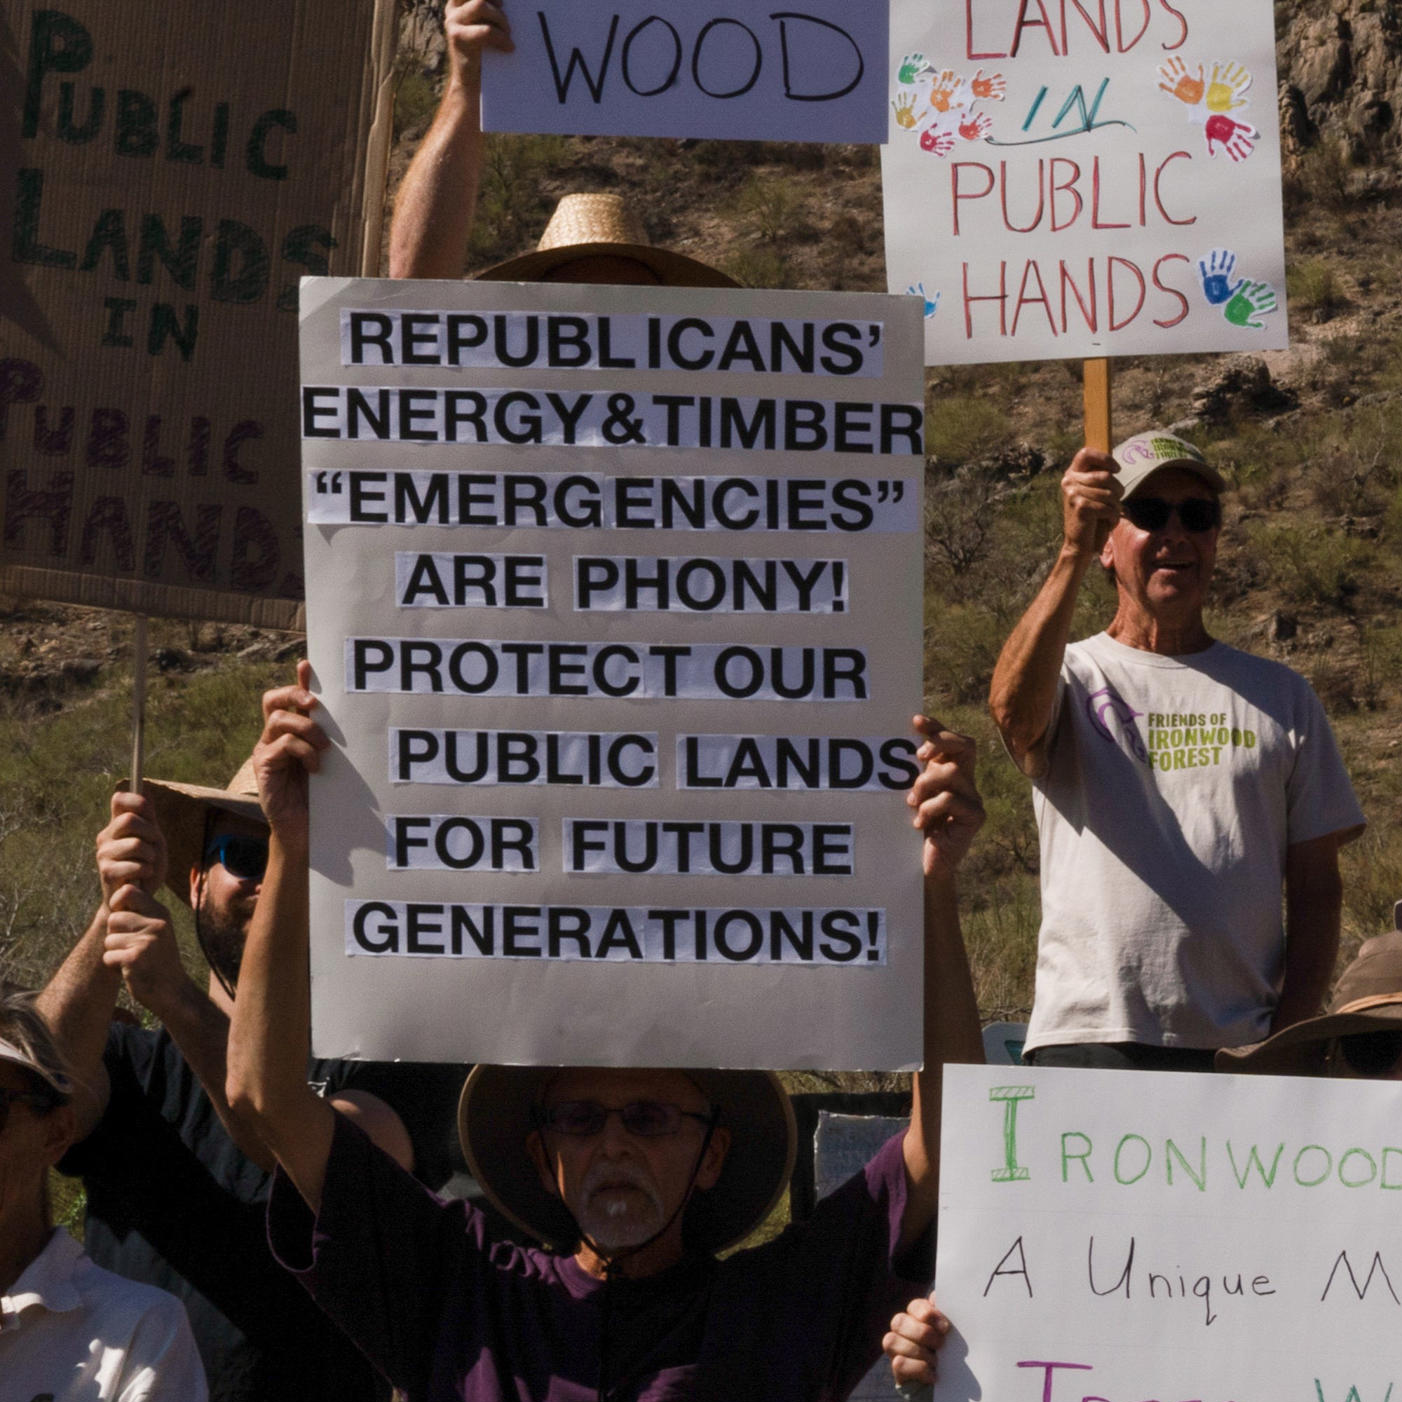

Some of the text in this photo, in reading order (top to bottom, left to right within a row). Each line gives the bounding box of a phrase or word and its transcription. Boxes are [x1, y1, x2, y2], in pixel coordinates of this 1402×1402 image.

[537, 11, 864, 104] WOOD
[966, 0, 1188, 59] LANDS
[22, 10, 298, 181] PUBLIC
[1021, 76, 1110, 132] IN
[951, 151, 1197, 236] PUBLIC
[13, 168, 338, 312] LANDS
[963, 253, 1190, 339] HANDS
[103, 297, 199, 362] IN
[4, 467, 305, 599] HAND
[402, 553, 845, 612] ARE PHONY!
[353, 638, 868, 700] PROTECT OUR
[1148, 712, 1227, 728] FRIENDS OF
[1148, 727, 1256, 750] IRONWOOD
[397, 729, 920, 791] PUBLIC LANDS
[1149, 746, 1223, 772] FOREST
[395, 816, 853, 875] FOR FUTURE
[352, 900, 881, 962] GENERATIONS!
[982, 1235, 1033, 1299] A
[1087, 1235, 1278, 1326] Unique
